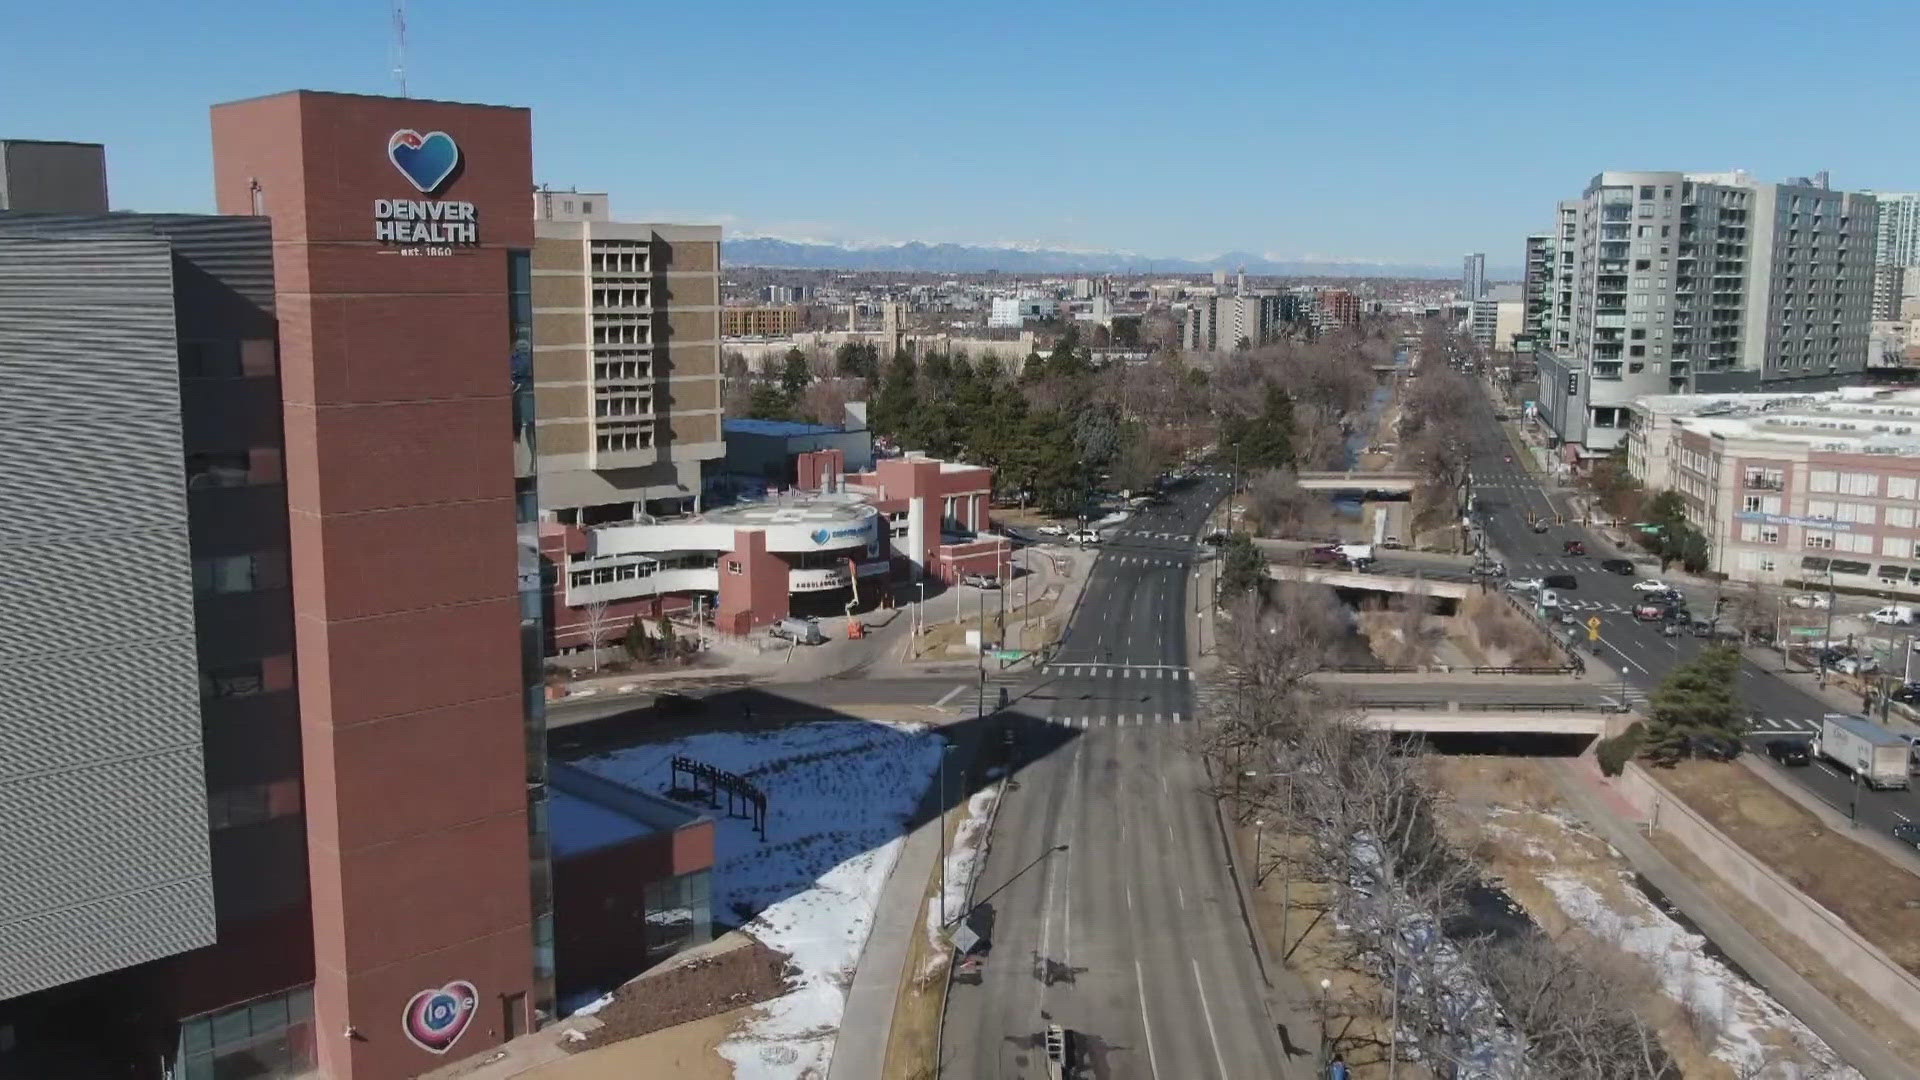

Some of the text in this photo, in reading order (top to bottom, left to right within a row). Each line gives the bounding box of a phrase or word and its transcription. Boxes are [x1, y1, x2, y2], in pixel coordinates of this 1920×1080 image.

[375, 199, 474, 222] DENVER
[376, 221, 475, 243] HEALTH
[428, 997, 474, 1022] love
